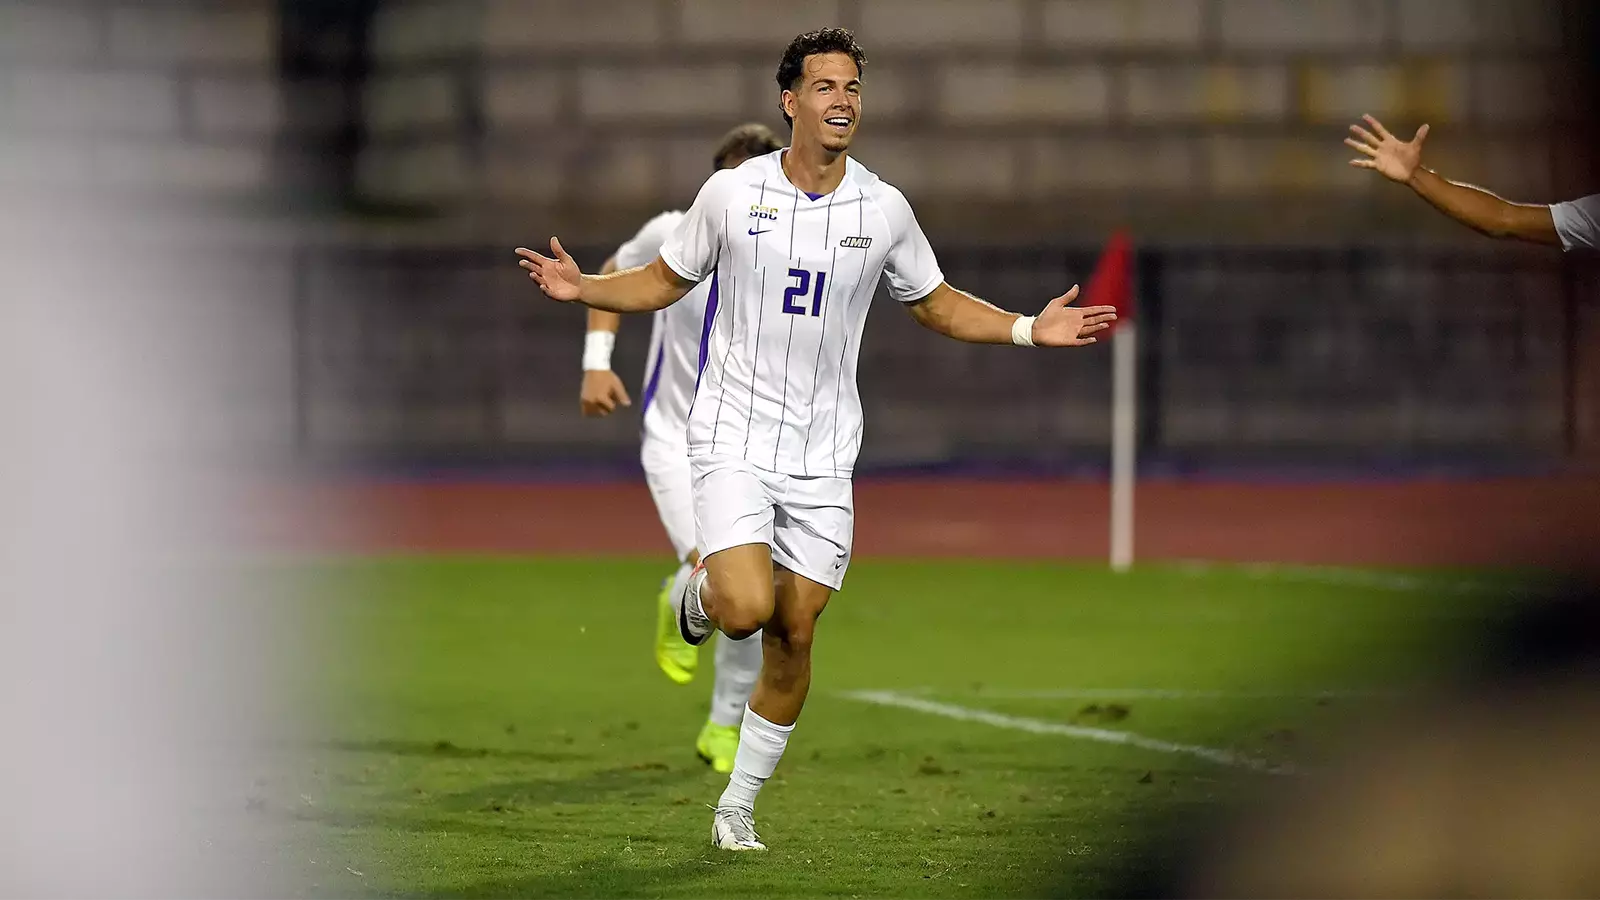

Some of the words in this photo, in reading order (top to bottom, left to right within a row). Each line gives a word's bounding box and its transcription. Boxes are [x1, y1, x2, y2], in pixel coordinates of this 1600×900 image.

[749, 205, 779, 221] SBC
[840, 236, 873, 249] JMU
[782, 268, 826, 317] 21
